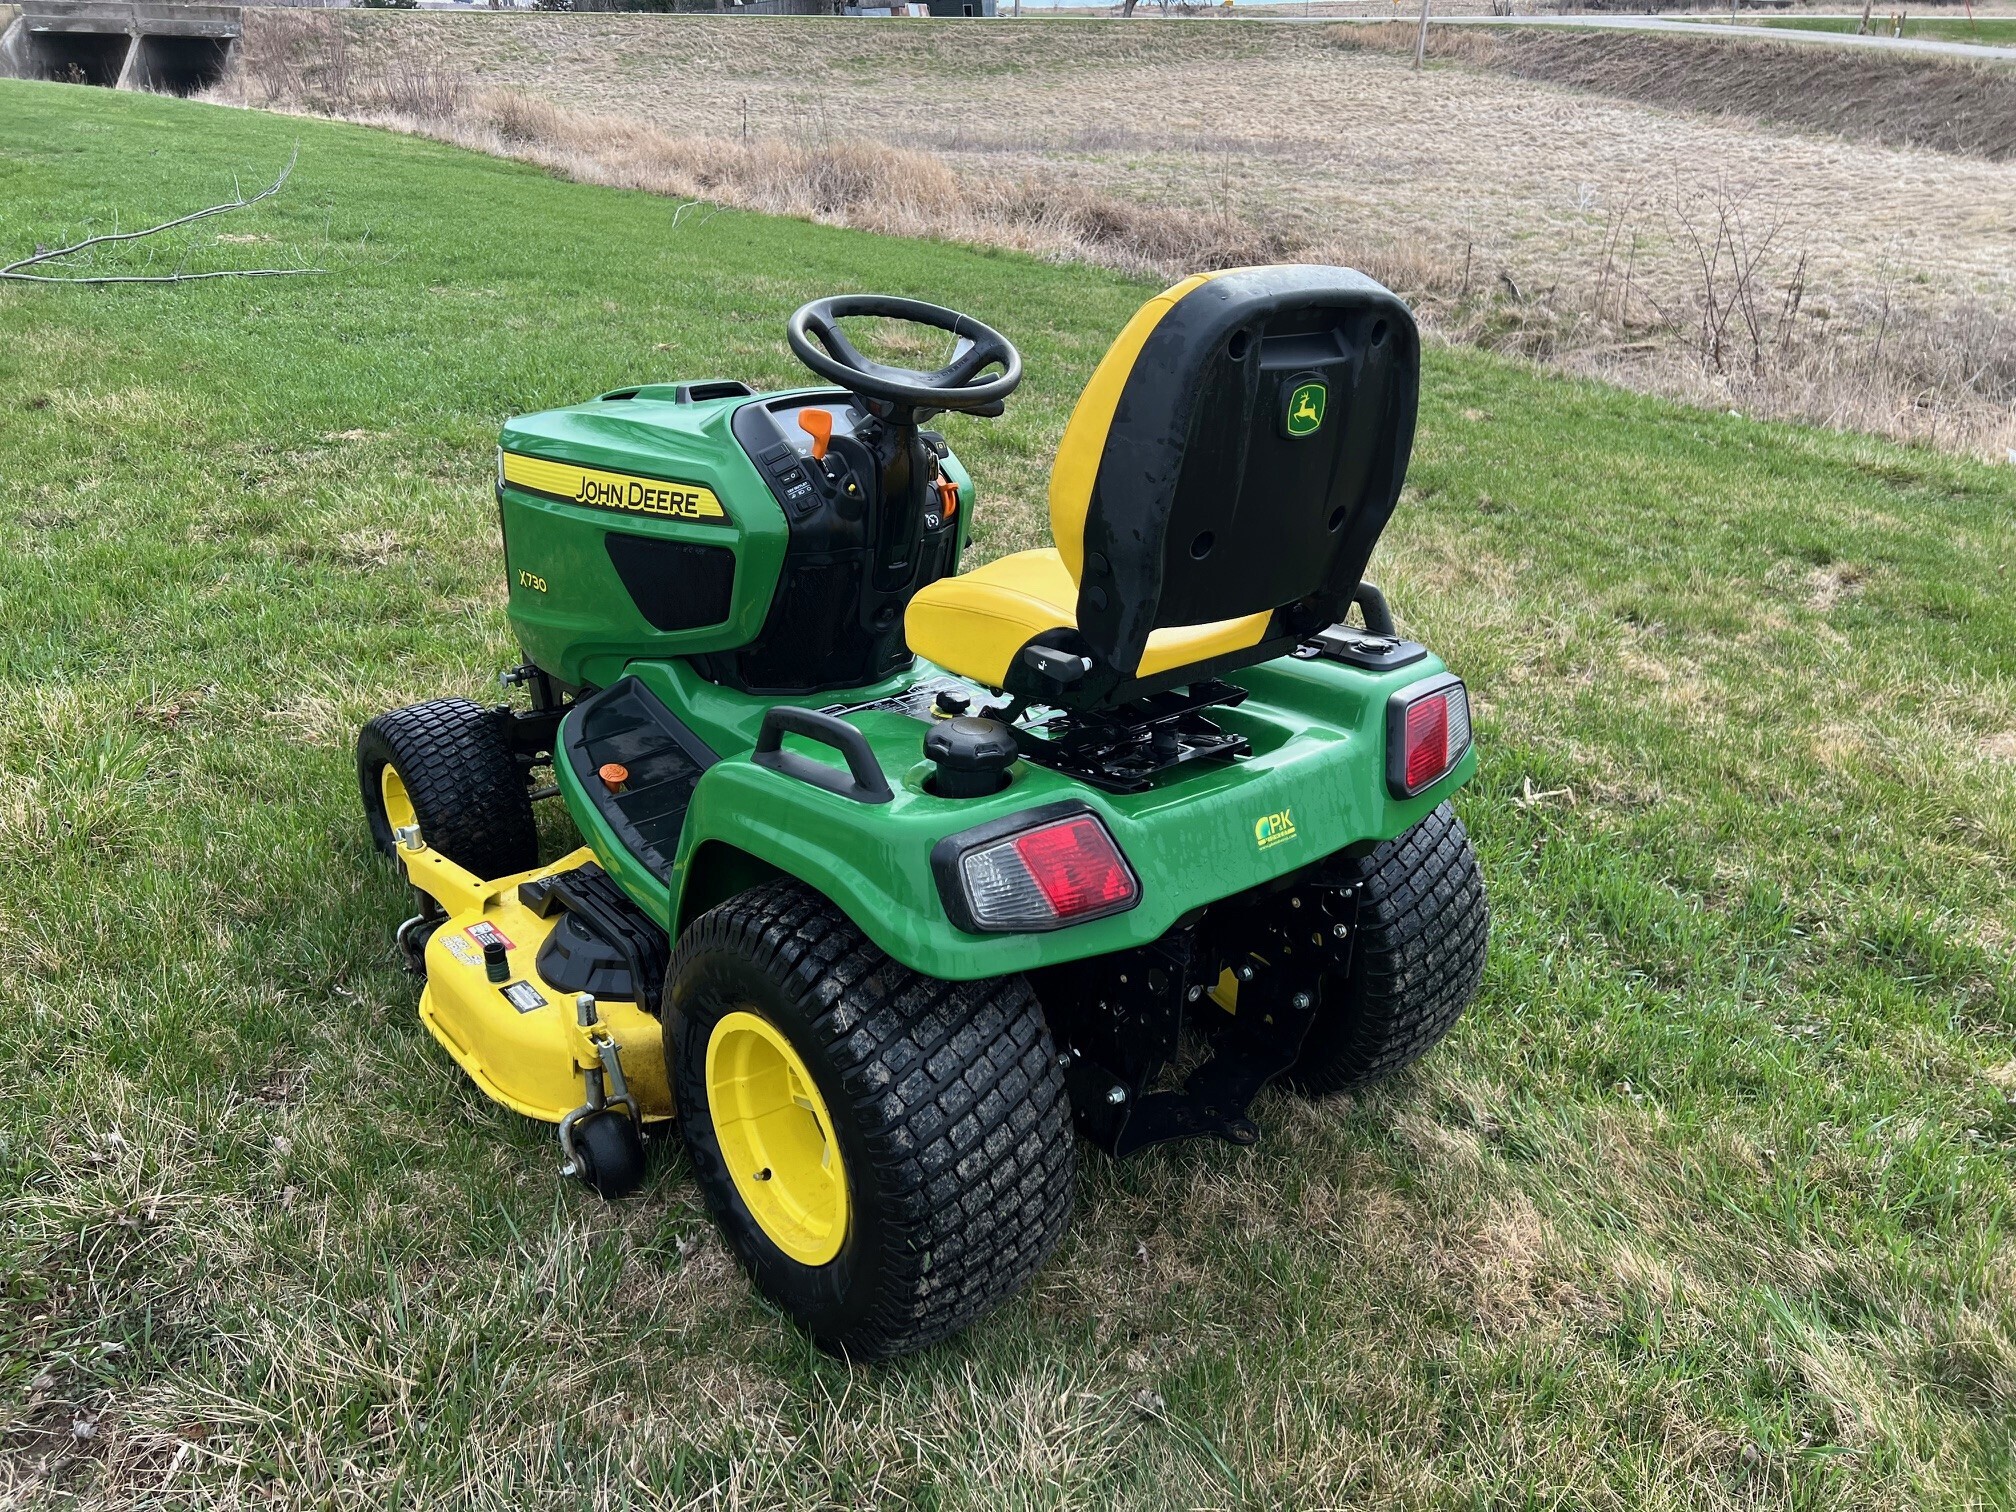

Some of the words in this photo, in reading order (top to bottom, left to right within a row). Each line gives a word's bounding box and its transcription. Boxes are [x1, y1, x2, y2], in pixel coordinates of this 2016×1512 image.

[575, 475, 623, 505] JOHN
[627, 481, 699, 515] DEERE
[518, 568, 547, 592] X730
